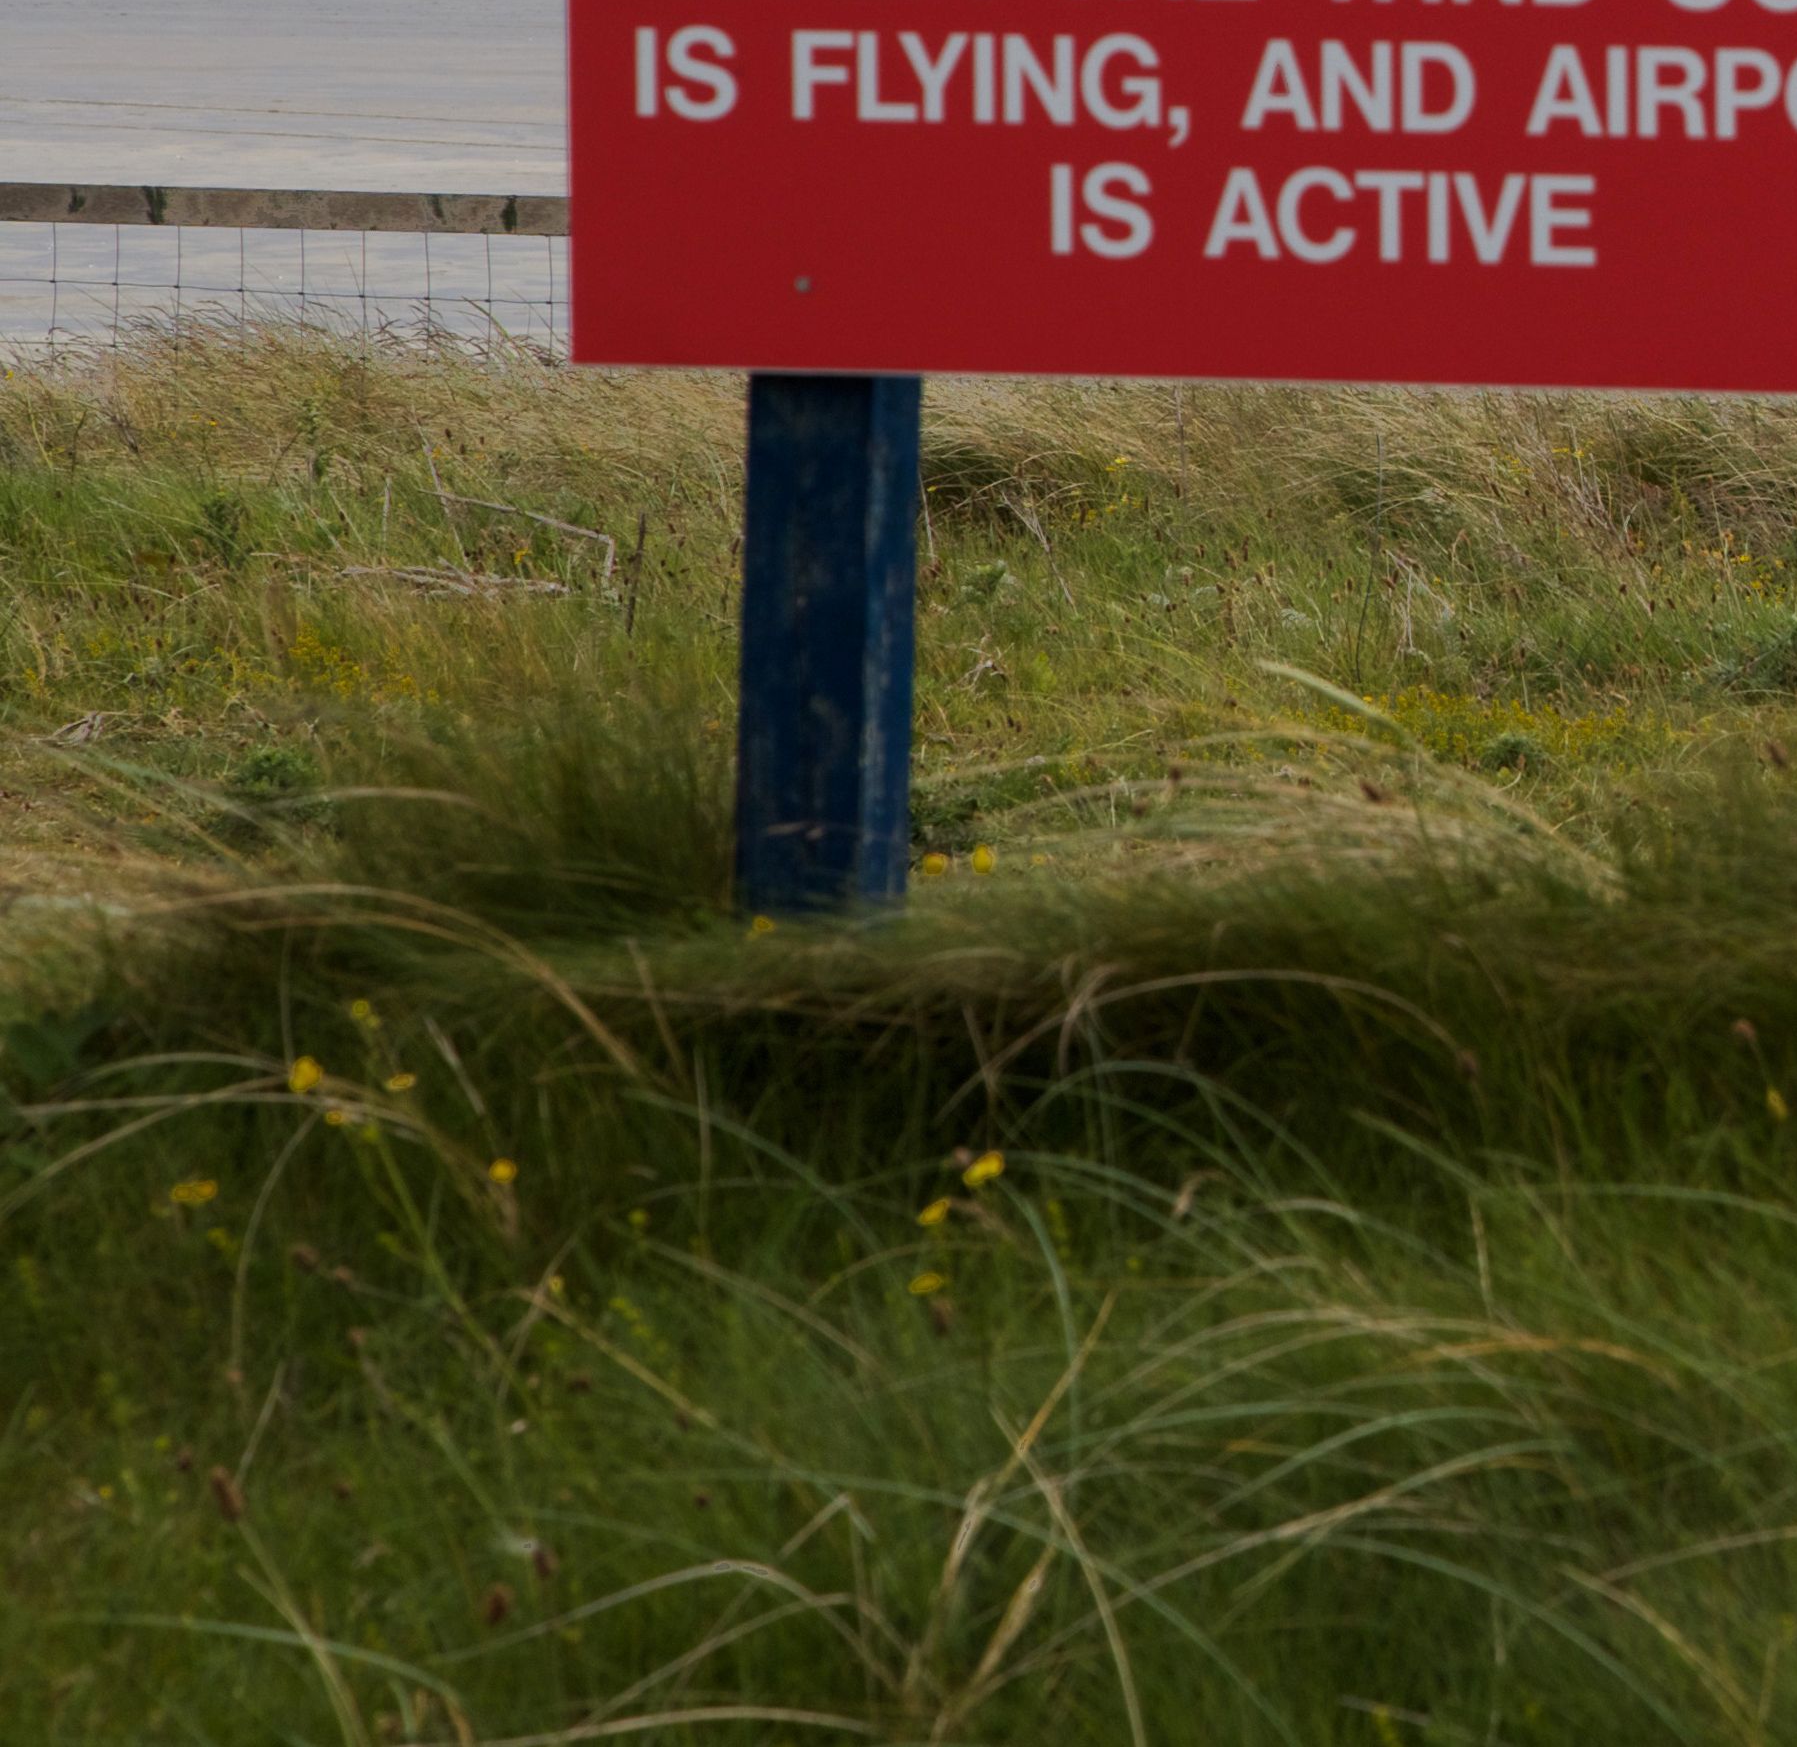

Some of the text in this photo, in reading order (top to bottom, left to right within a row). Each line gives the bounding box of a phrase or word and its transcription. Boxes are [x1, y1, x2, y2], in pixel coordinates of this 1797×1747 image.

[636, 26, 736, 120] IS
[793, 30, 1190, 149] FLYING,
[1242, 39, 1475, 133] AND
[1052, 163, 1596, 266] IS ACTIVE
